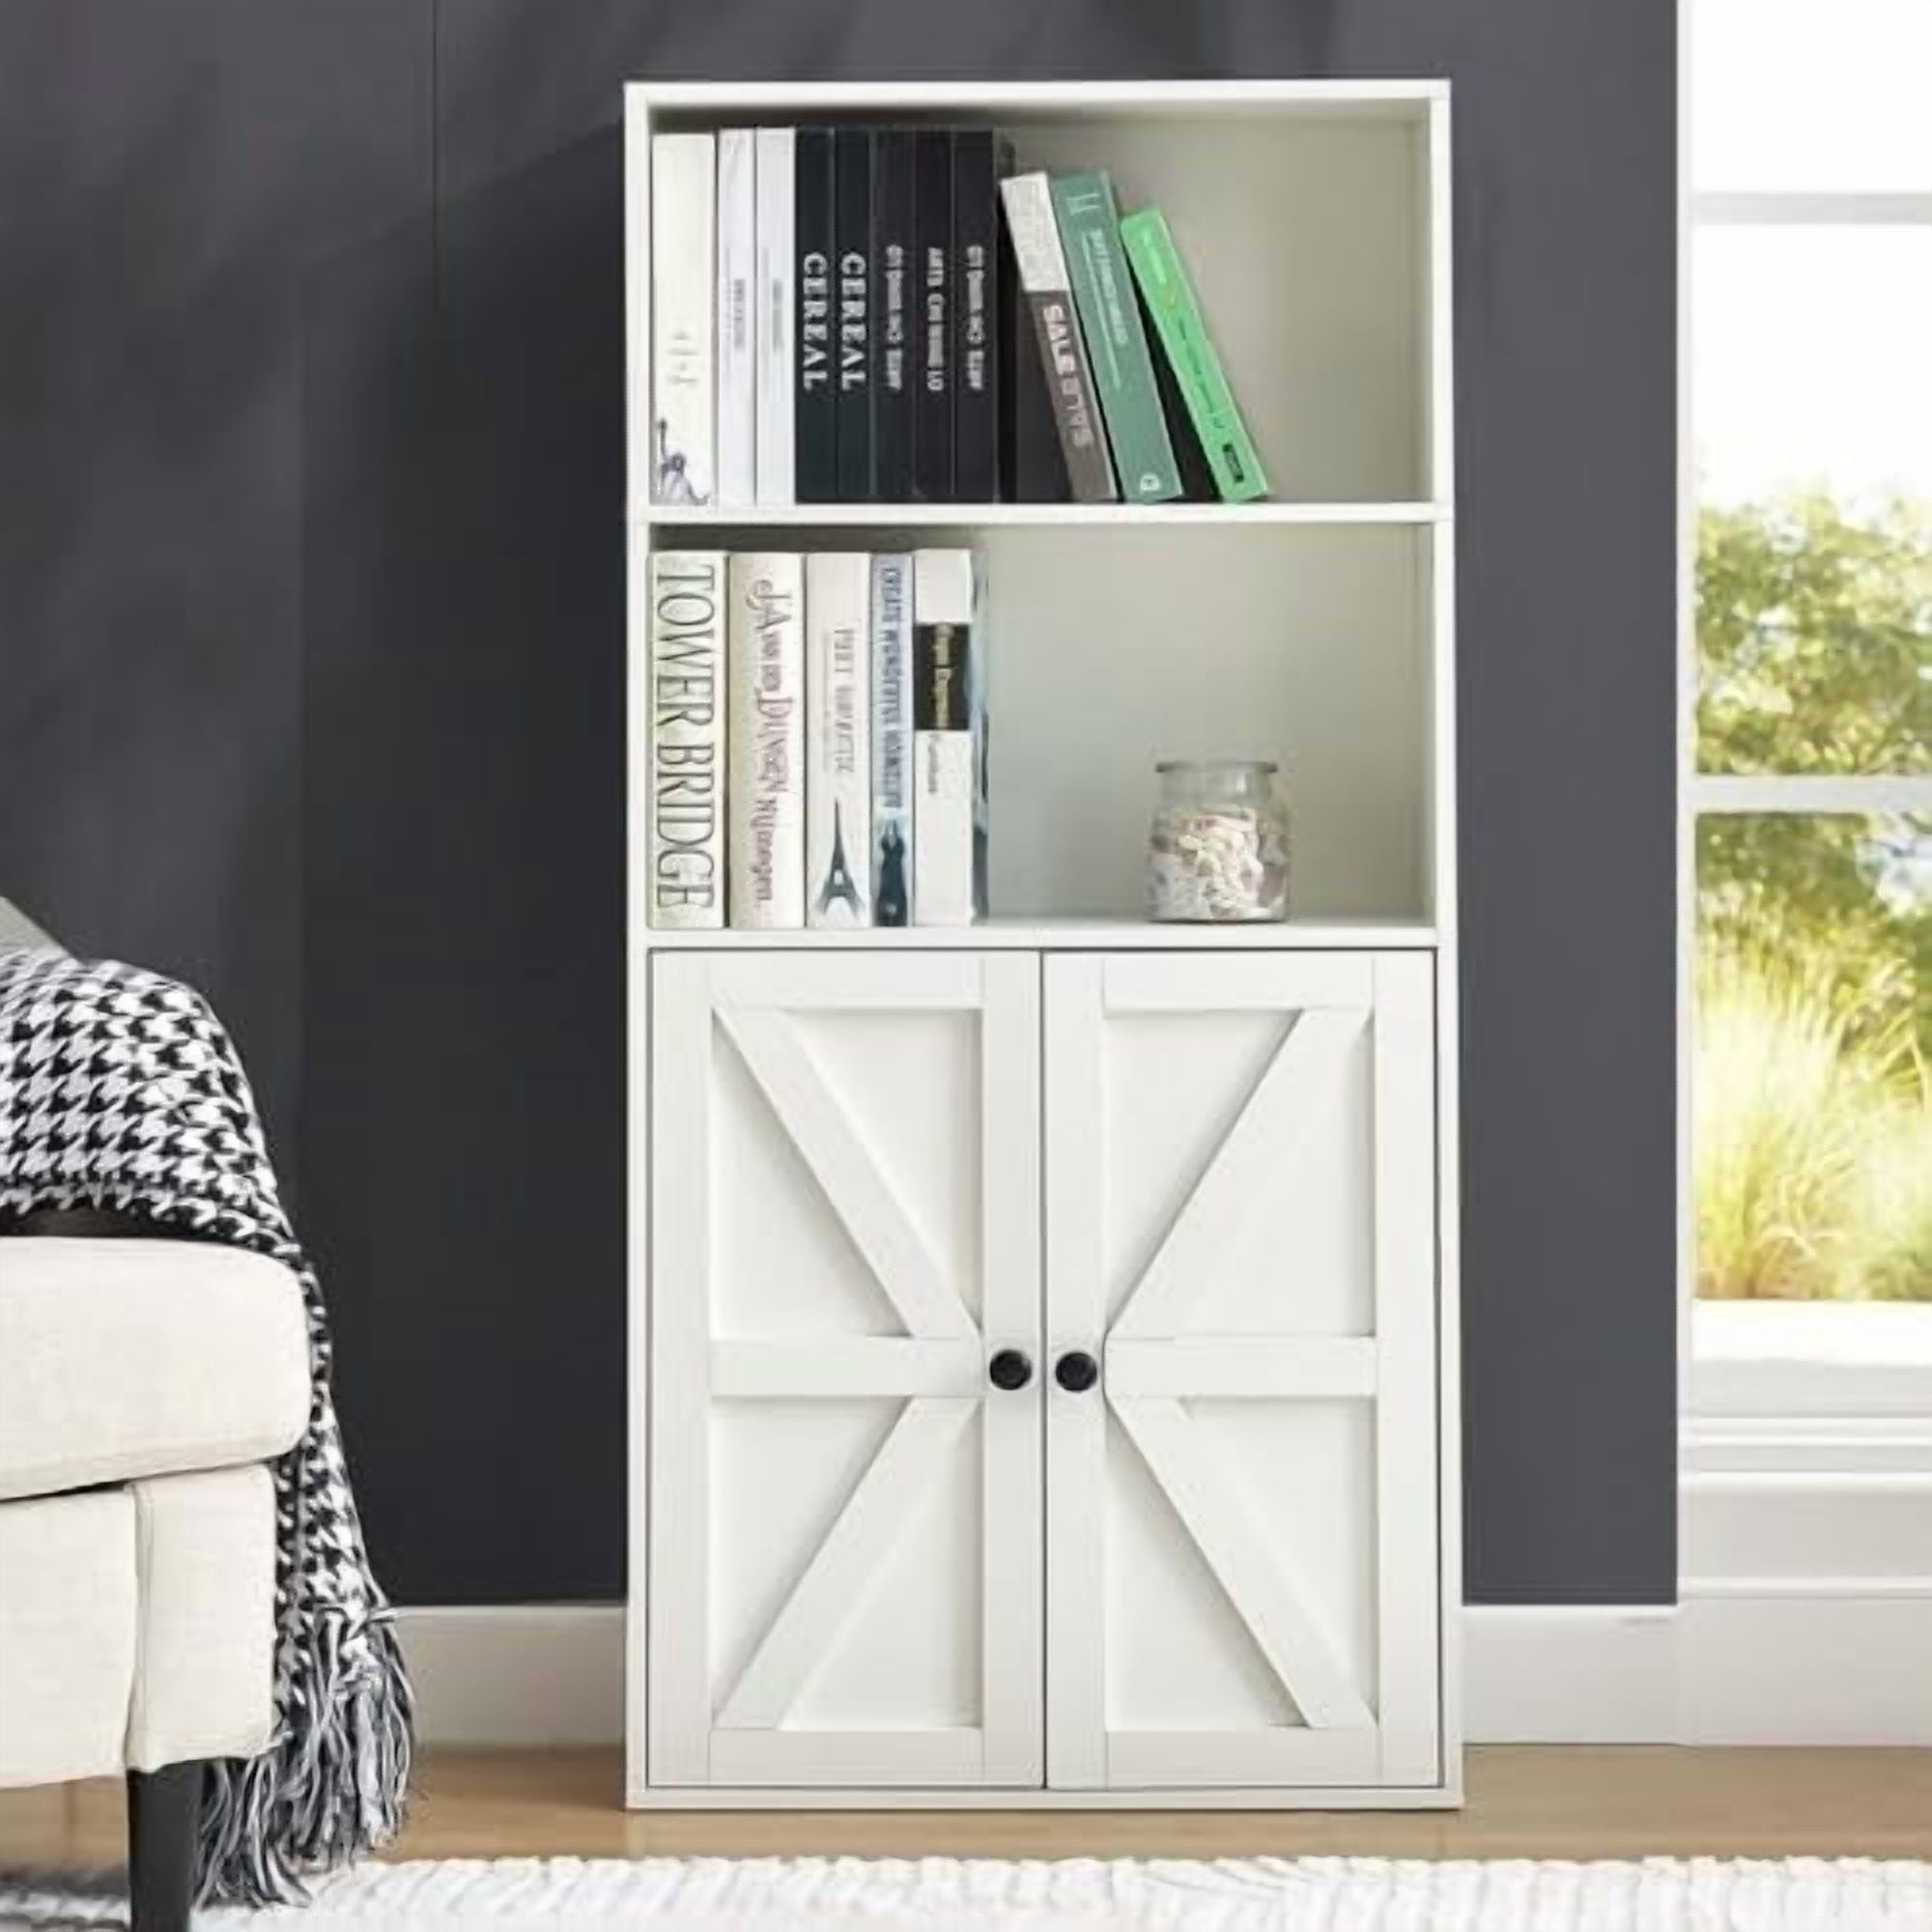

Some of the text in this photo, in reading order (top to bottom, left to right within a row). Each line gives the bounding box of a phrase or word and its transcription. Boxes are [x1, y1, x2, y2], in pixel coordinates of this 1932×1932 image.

[803, 252, 828, 390] CEREAL
[841, 252, 866, 390] CEREAL
[1042, 304, 1076, 375] SALE
[656, 565, 715, 909] TOWER BRIDGE
